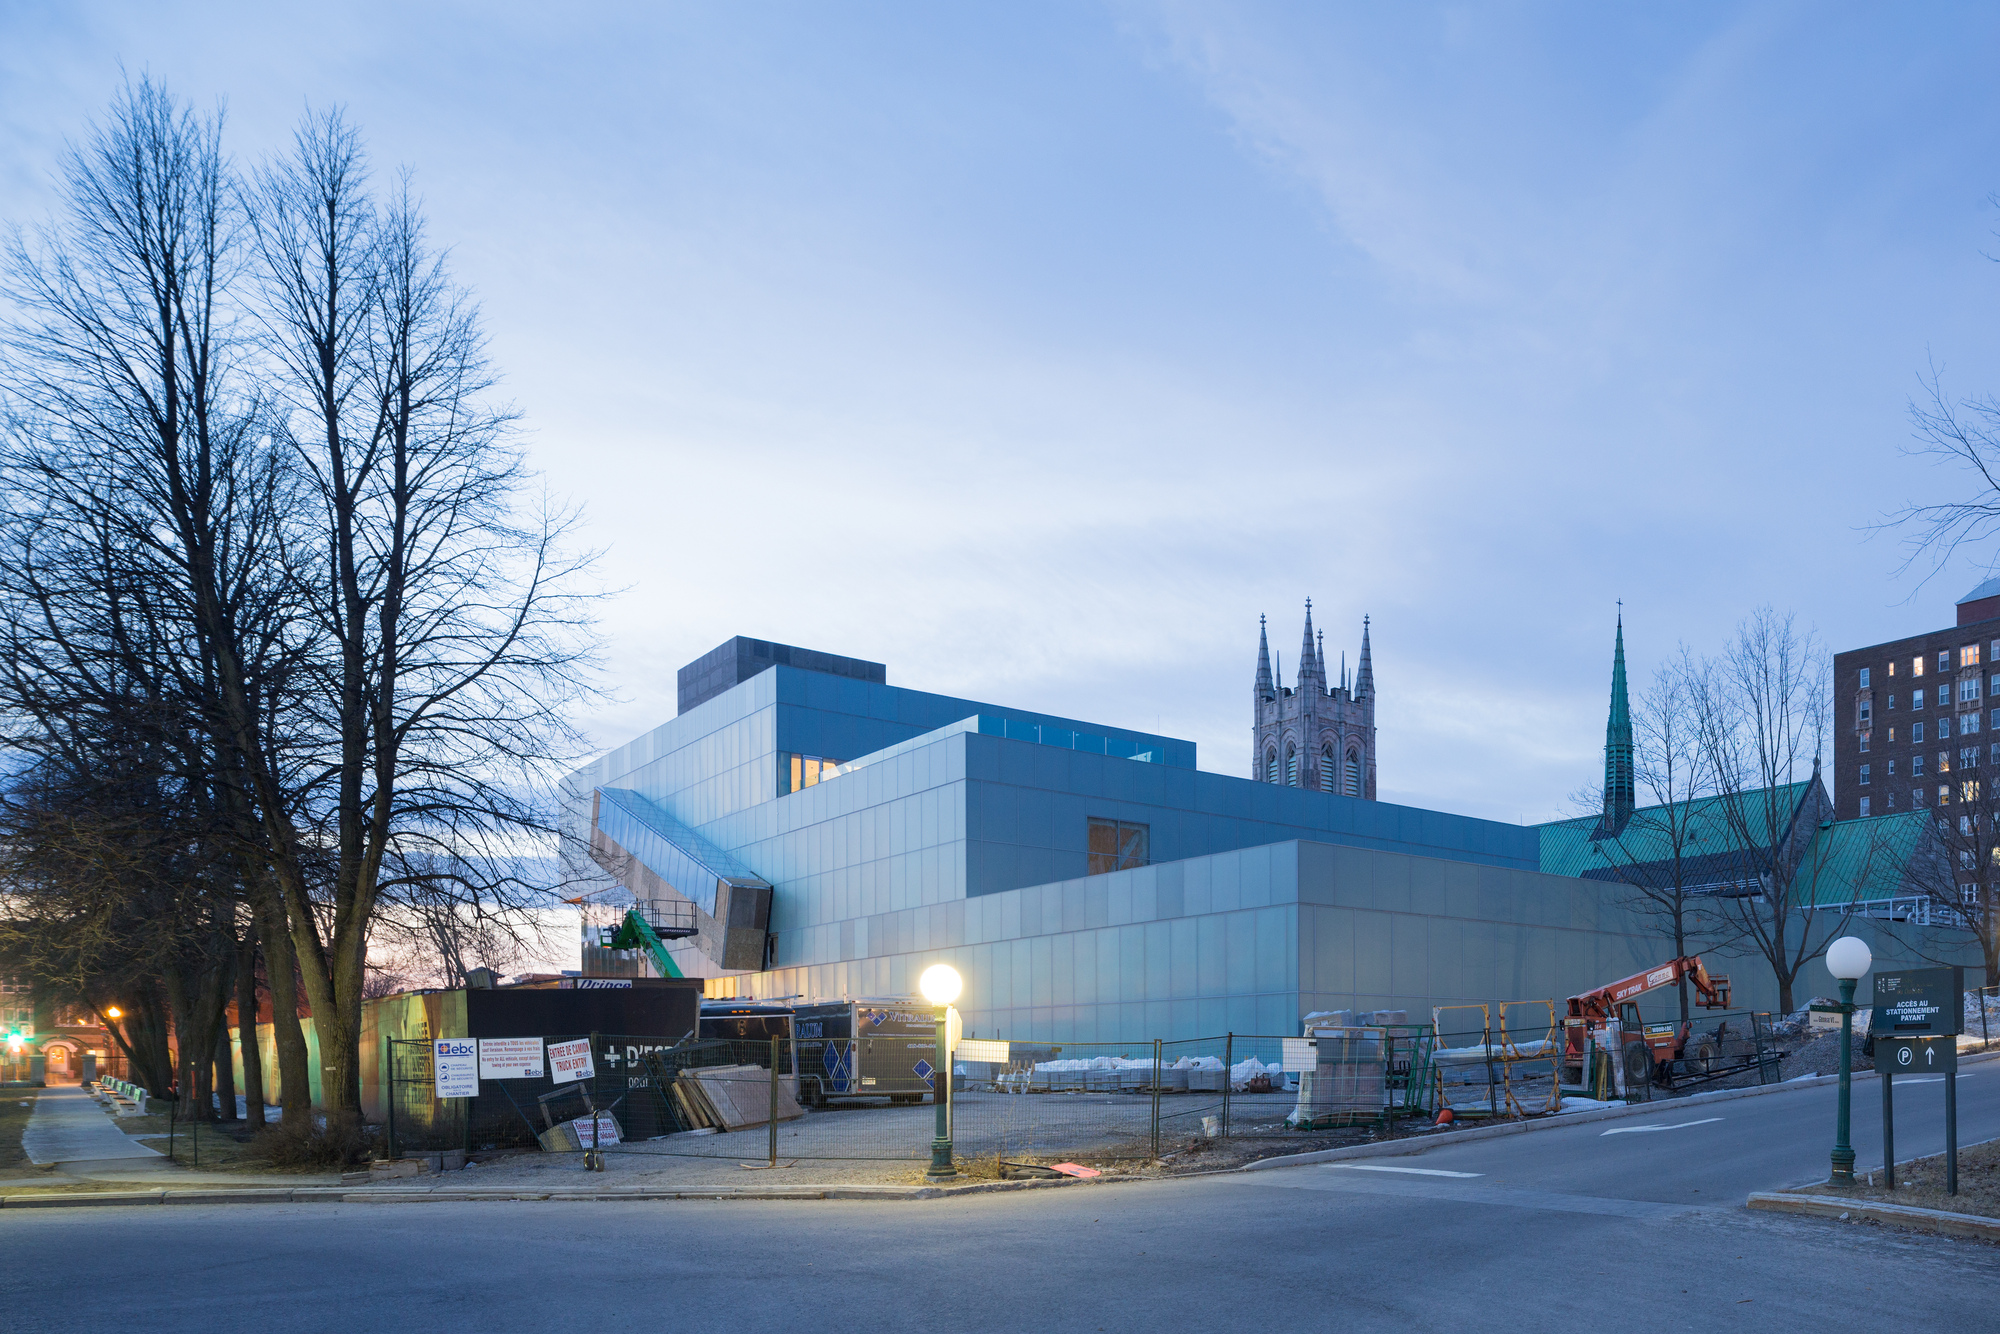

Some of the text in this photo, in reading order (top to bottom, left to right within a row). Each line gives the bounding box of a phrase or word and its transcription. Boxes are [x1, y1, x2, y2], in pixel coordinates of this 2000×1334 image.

[1616, 983, 1642, 1000] SKY TRAK
[1885, 1006, 1940, 1015] STATIONNEMENT
[1896, 999, 1918, 1008] ACCÈS
[795, 1022, 823, 1039] RALUM
[451, 1042, 474, 1055] ebc
[549, 1042, 590, 1059] ENTRÉE DE CAMION
[555, 1057, 587, 1072] TRUCK ENTRY
[582, 1069, 594, 1077] ebc
